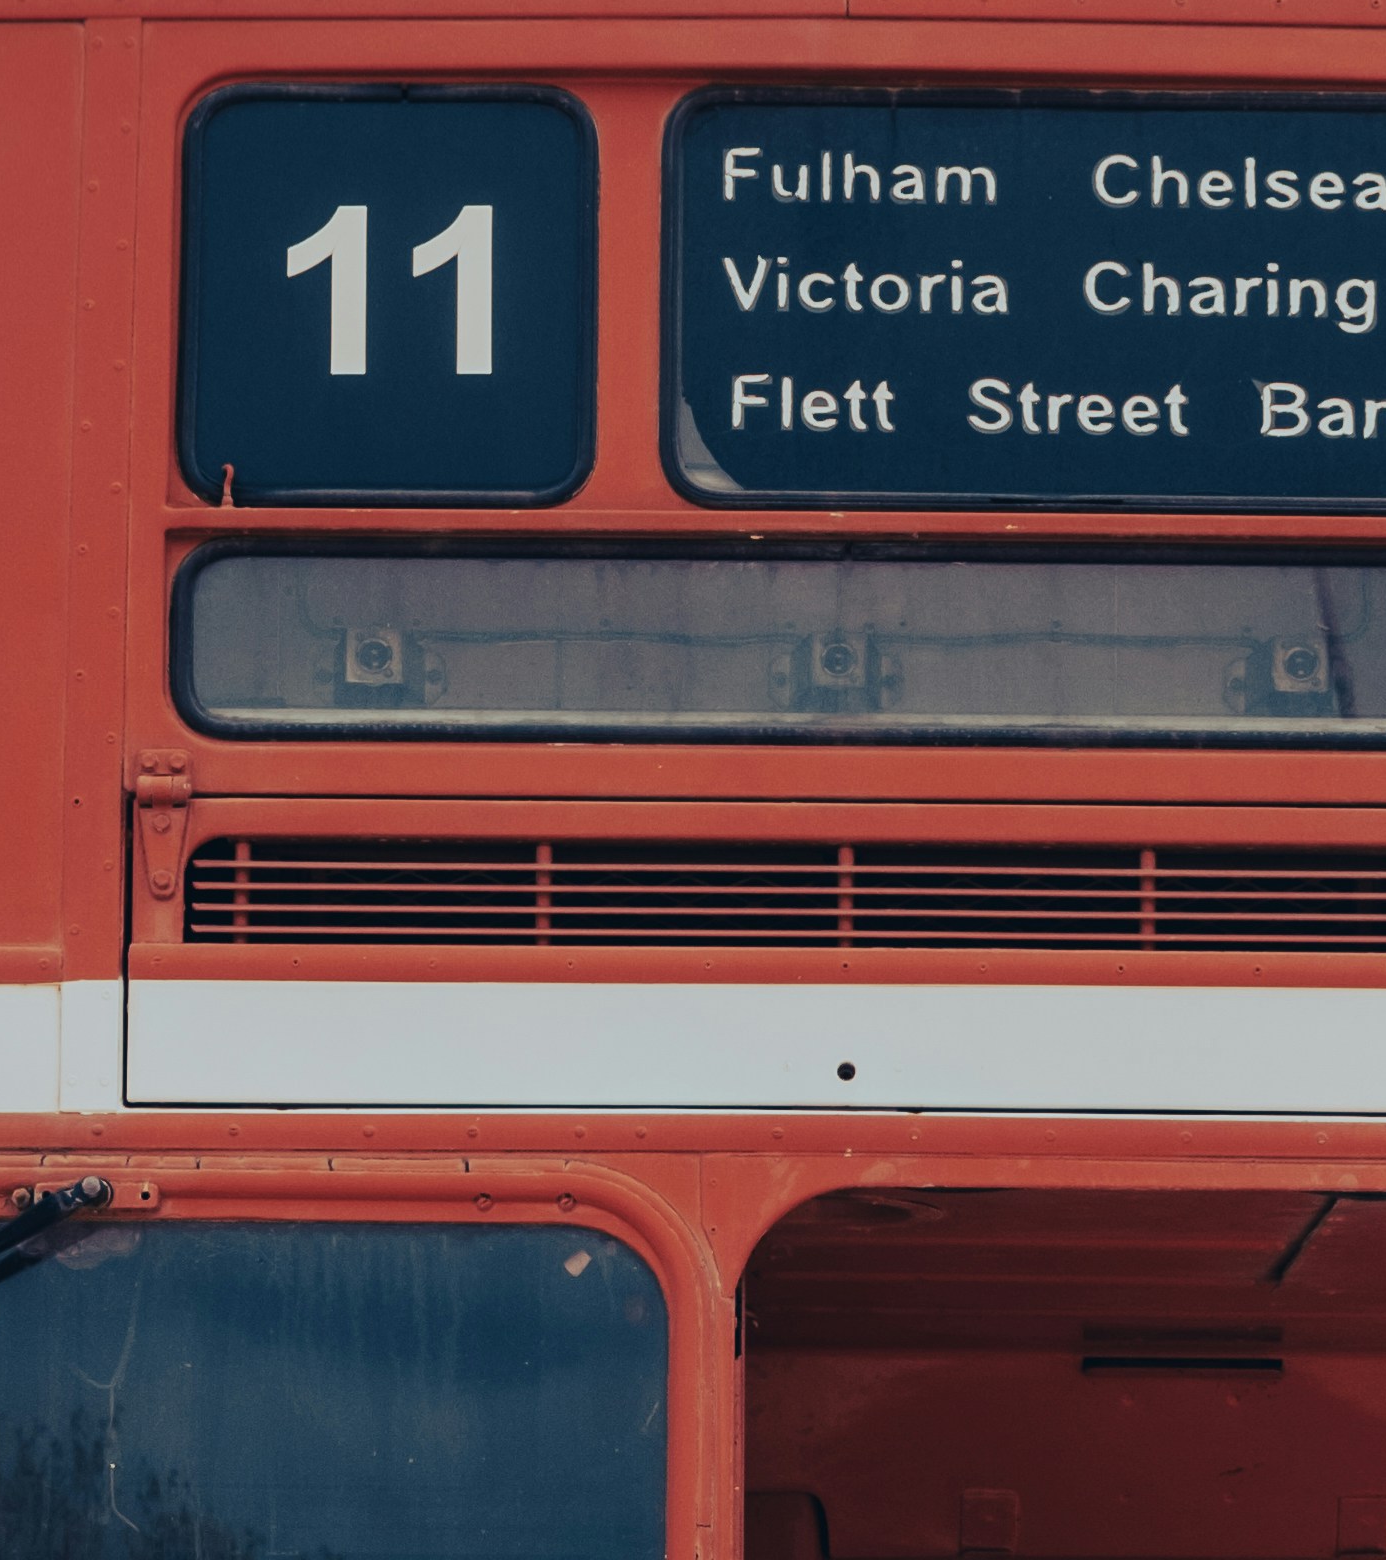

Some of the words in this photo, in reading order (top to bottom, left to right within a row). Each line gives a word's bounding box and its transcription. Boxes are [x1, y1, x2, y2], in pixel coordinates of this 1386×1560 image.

[722, 146, 999, 205] Fulham
[286, 204, 493, 376] 11
[722, 253, 1011, 316] Victoria
[1081, 260, 1378, 335] Charing
[729, 372, 897, 432] Flett
[966, 377, 1191, 438] Street
